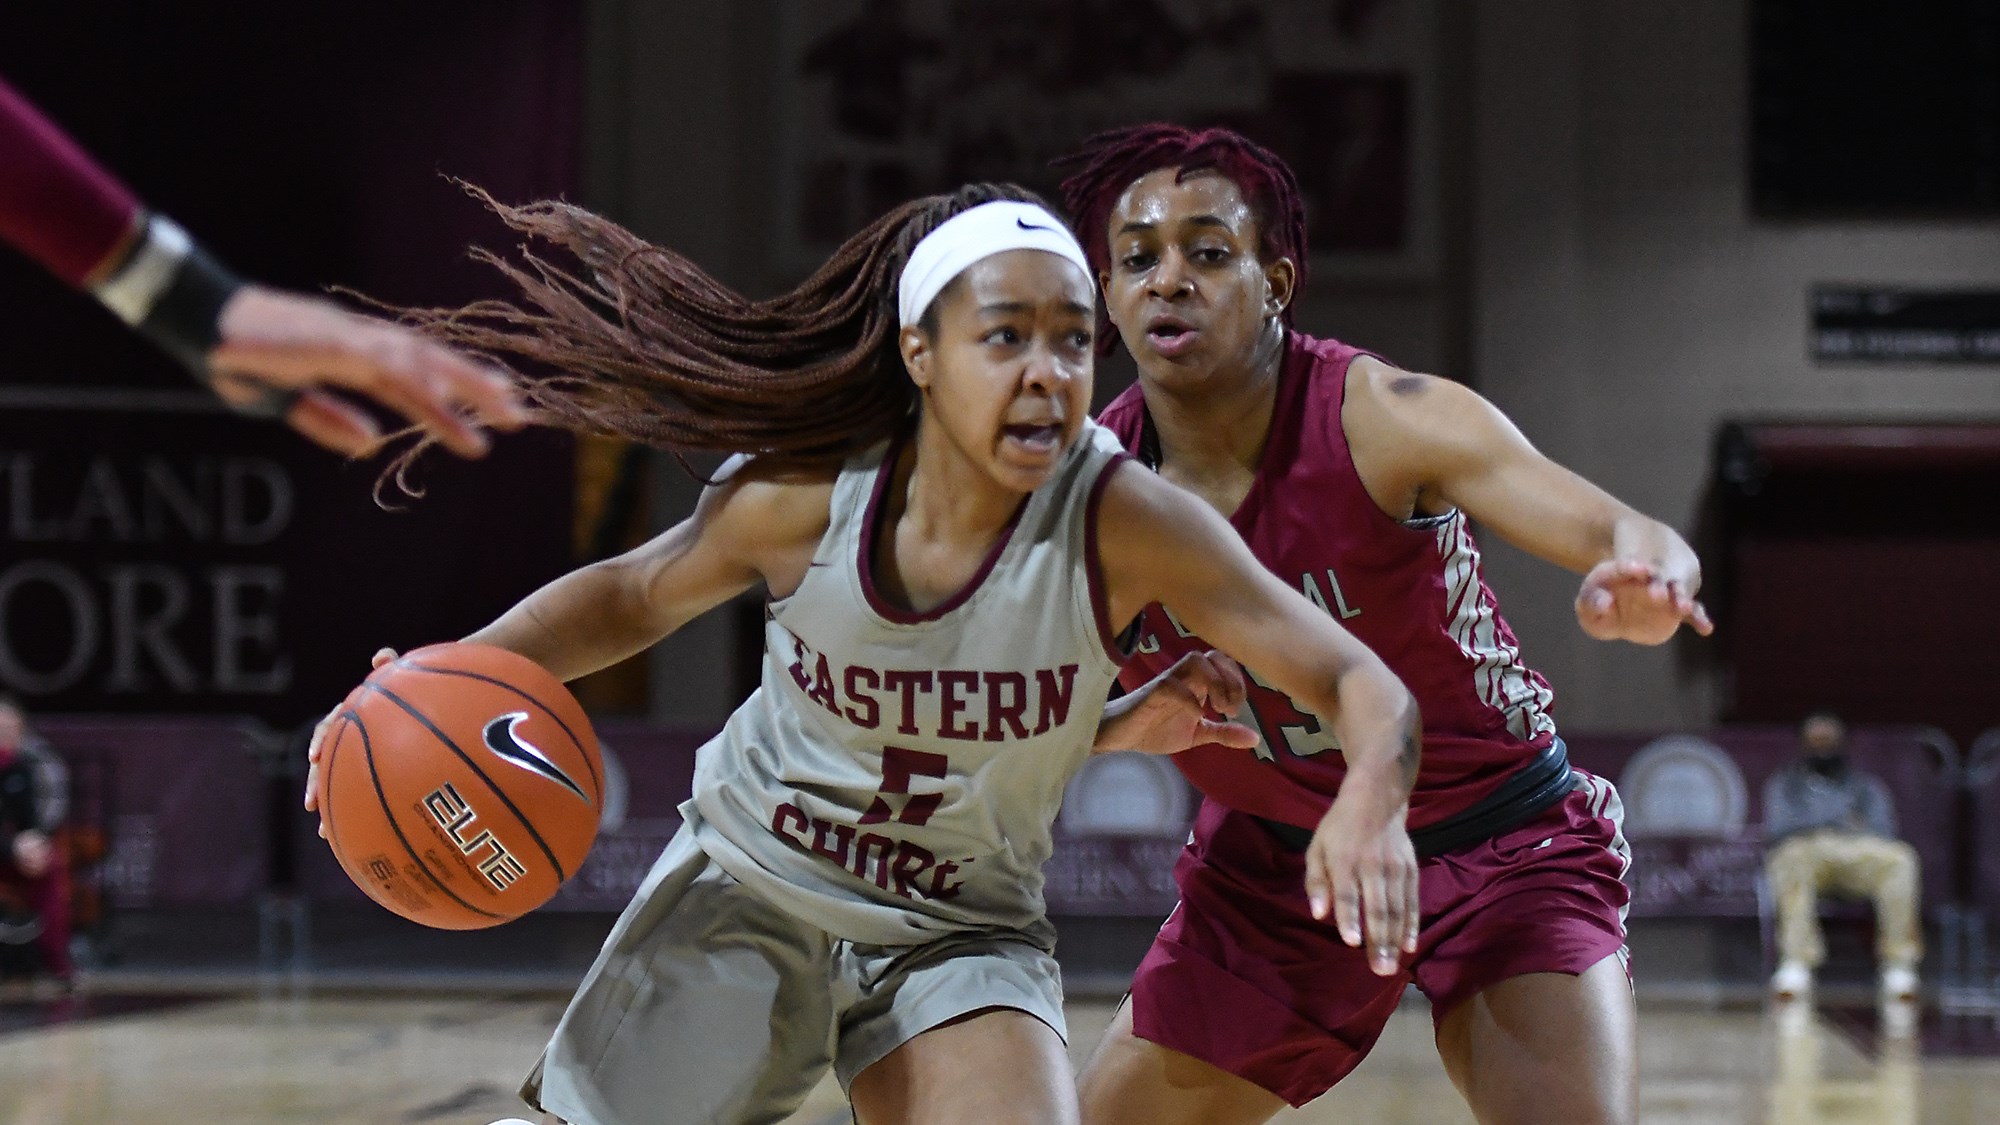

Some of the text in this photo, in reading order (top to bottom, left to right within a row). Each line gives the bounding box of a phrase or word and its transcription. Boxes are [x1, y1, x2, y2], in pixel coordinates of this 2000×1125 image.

[0, 452, 296, 546] LAND
[789, 639, 1079, 742] EASTERN
[857, 746, 949, 827] 5
[422, 782, 528, 892] ELITE
